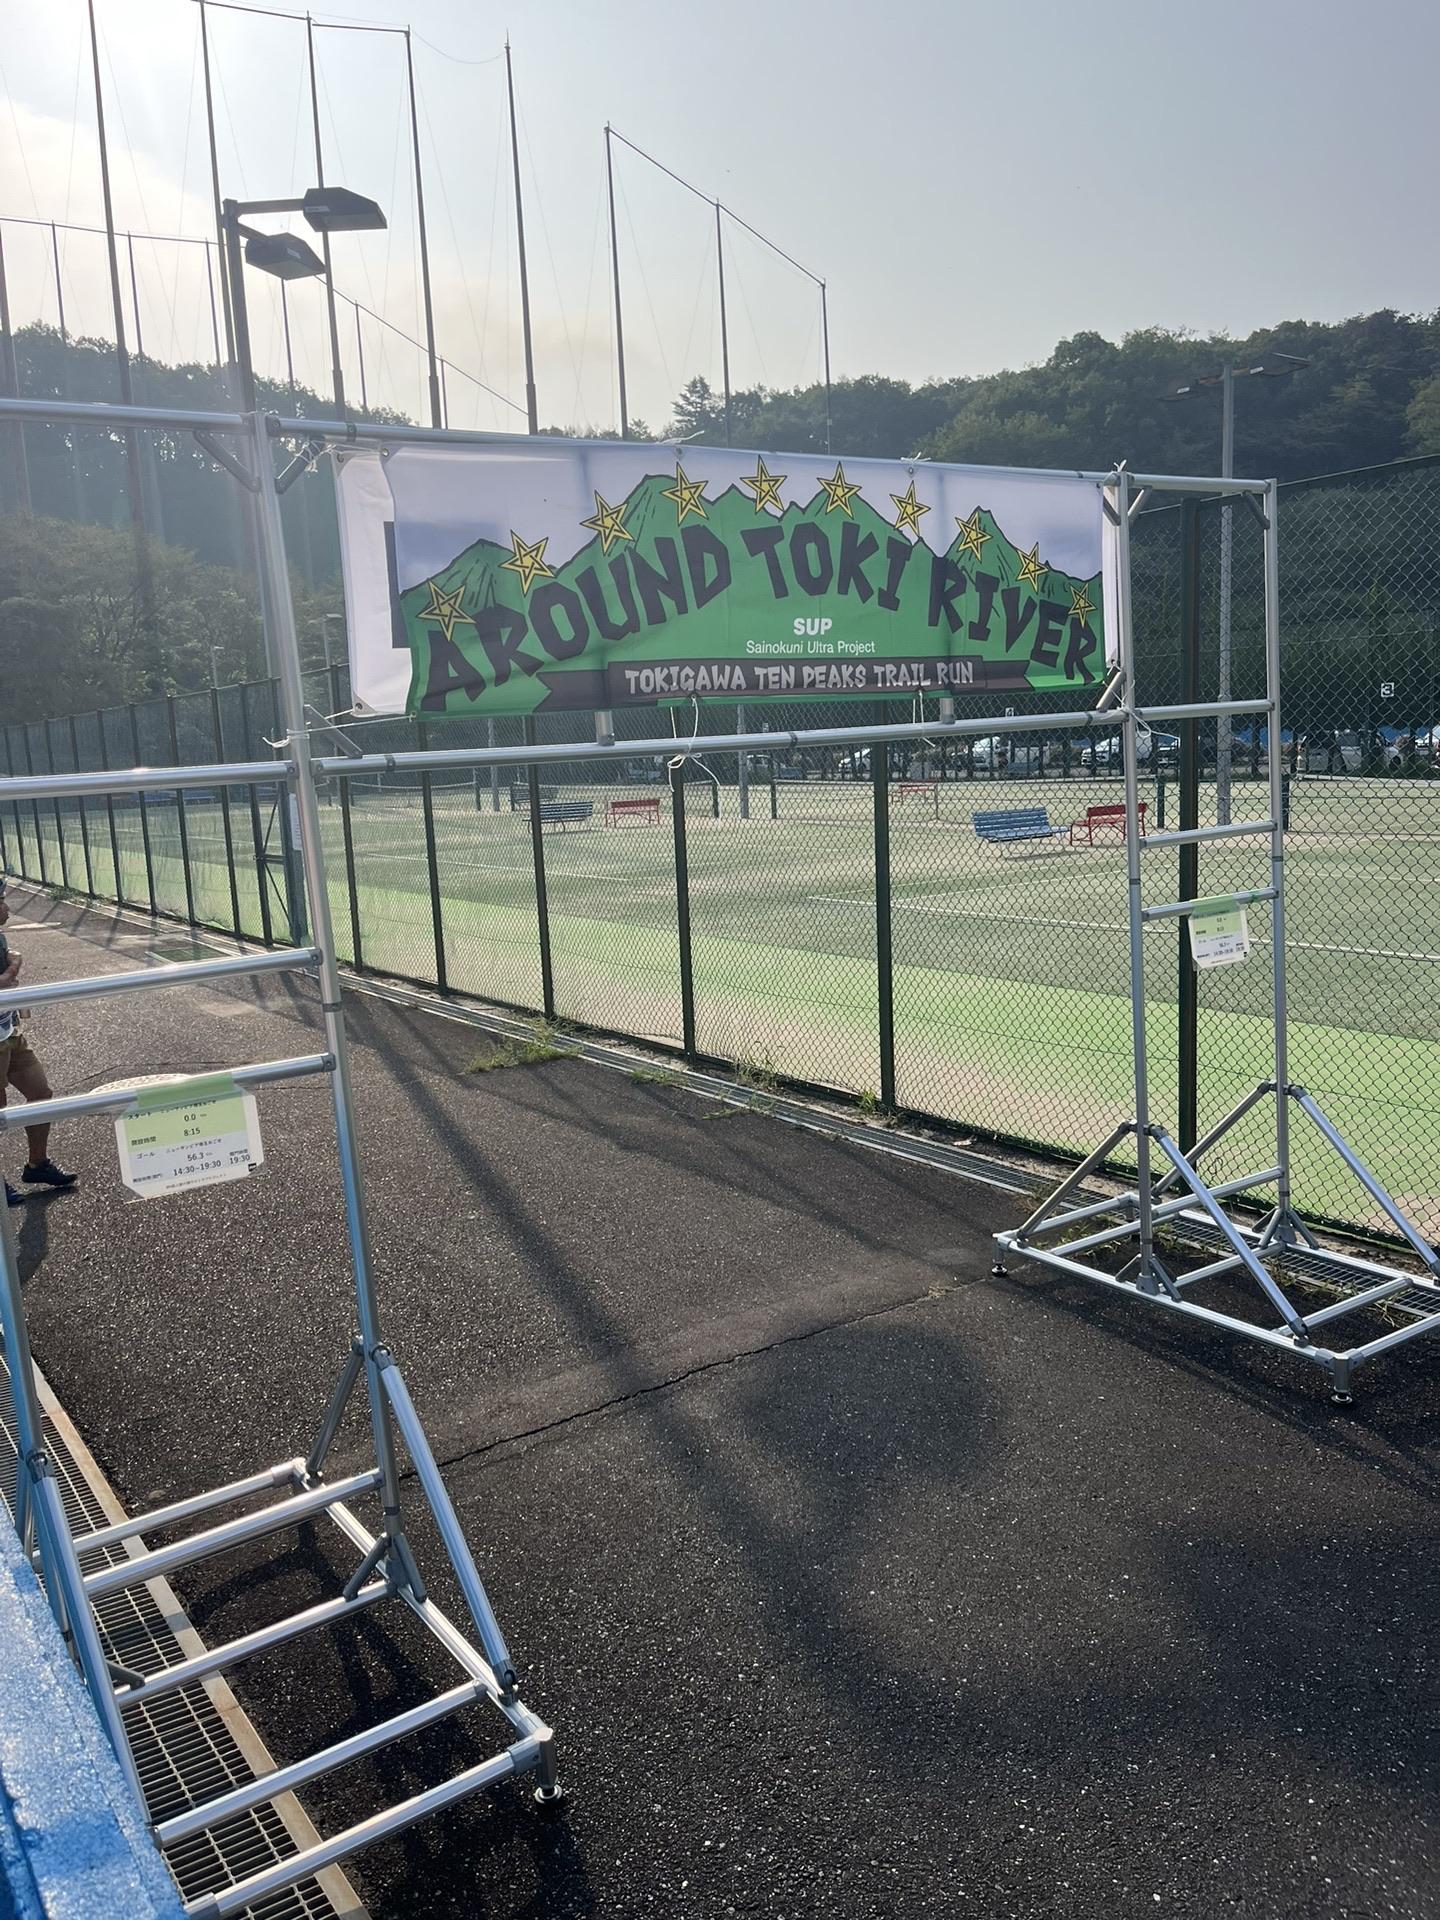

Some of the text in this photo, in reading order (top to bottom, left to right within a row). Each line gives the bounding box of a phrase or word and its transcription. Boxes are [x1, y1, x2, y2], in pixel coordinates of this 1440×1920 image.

[420, 521, 1097, 711] AROUND TOKI RIVER
[793, 617, 833, 636] SUP
[746, 640, 876, 656] Sainokuni Ultra Project
[624, 661, 974, 695] TOKIGAWA TEN PEAKS TRAIL RUN
[1383, 684, 1392, 695] 3
[183, 1127, 201, 1136] 8:15
[187, 1152, 204, 1162] 56.3
[229, 1155, 251, 1165] 19:30
